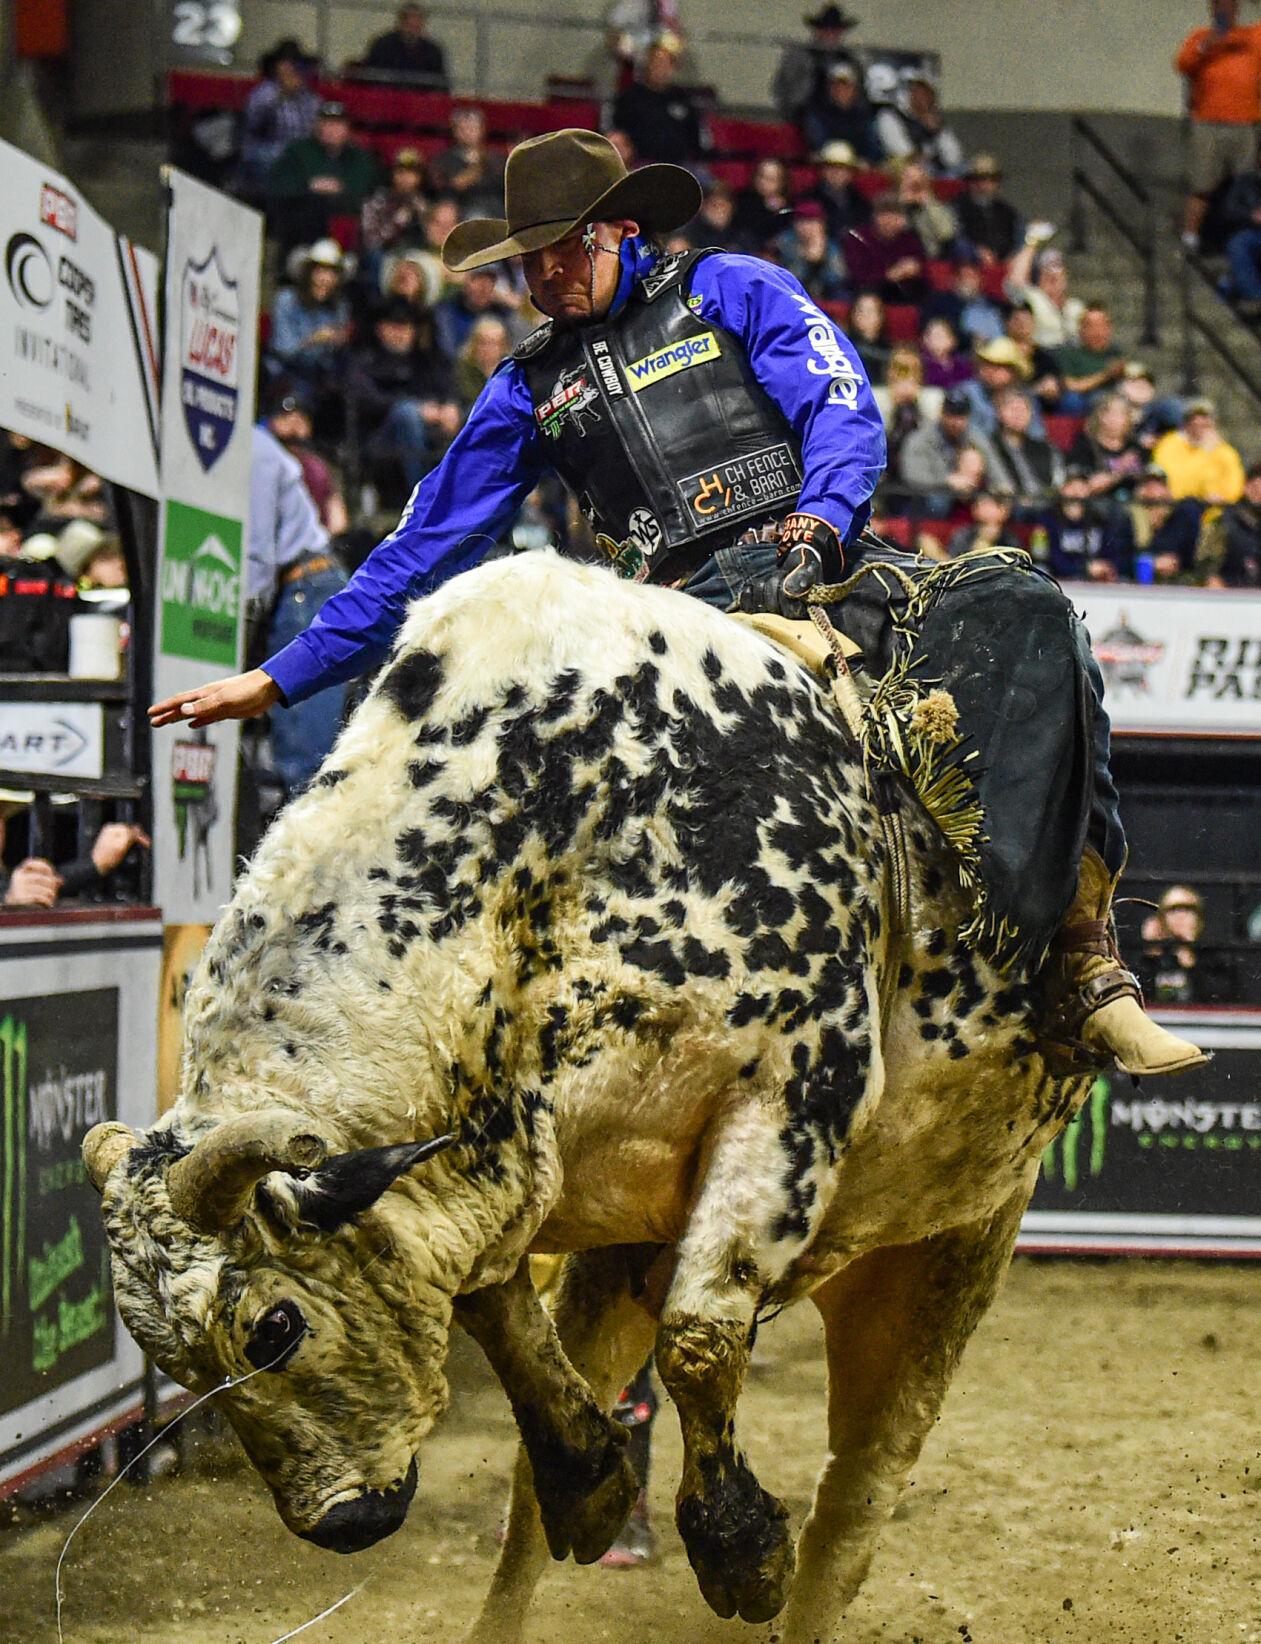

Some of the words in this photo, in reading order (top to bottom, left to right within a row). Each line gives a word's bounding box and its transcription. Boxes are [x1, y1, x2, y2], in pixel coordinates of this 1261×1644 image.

[592, 340, 609, 356] BE
[630, 337, 701, 379] Wrangler
[790, 294, 864, 411] Wrangler
[597, 355, 624, 396] COWBOY
[725, 461, 747, 484] CH
[747, 449, 791, 477] FENCE
[733, 484, 750, 502] &
[749, 470, 788, 496] BARN
